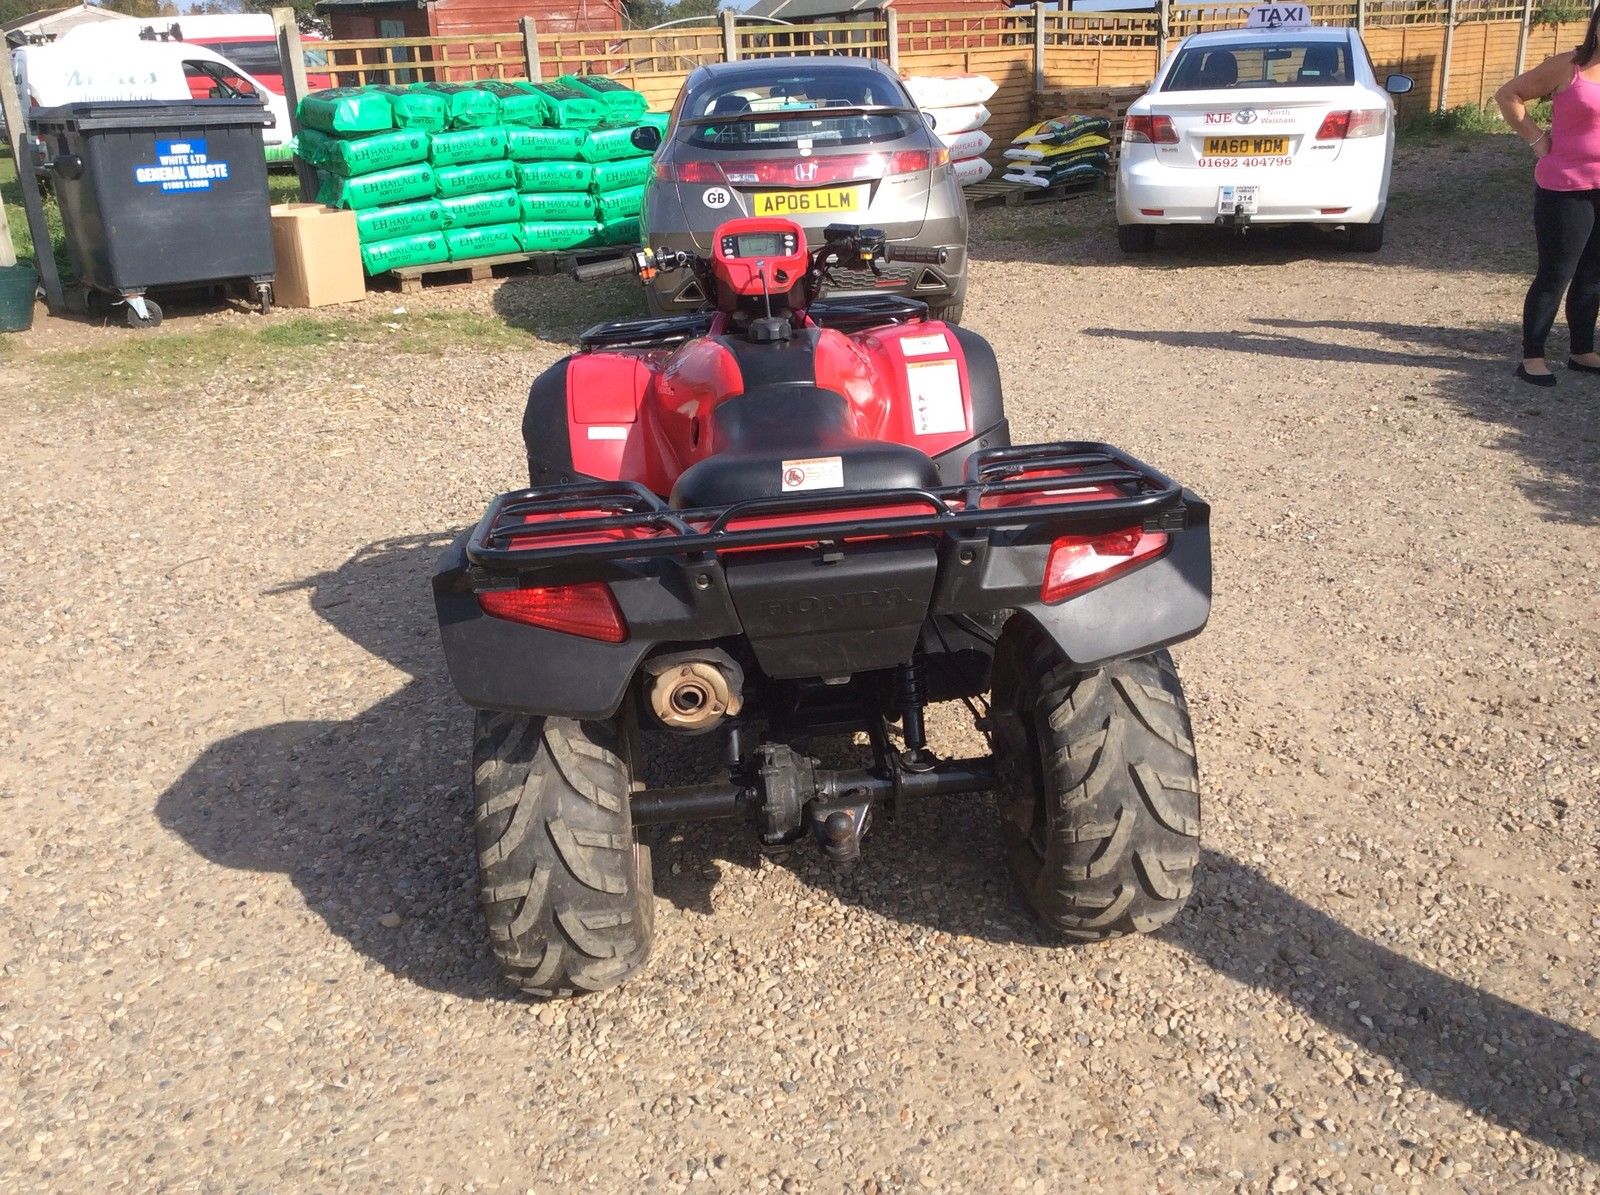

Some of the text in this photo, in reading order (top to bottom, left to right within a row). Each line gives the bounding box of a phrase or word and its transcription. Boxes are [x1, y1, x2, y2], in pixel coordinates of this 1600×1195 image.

[1257, 7, 1304, 22] TAXI
[1205, 112, 1232, 124] NJE
[436, 139, 487, 152] EH HAYLAGE
[521, 136, 570, 146] EH HAYLAGE
[596, 142, 609, 151] EH
[1210, 139, 1283, 154] MA60 WDM
[354, 142, 407, 161] EH HAYLAGE
[159, 153, 207, 166] WHITE LTD
[1198, 157, 1292, 168] 01692 404796
[136, 163, 228, 183] GENERAL WASTE
[526, 171, 572, 181] EH HAYLAGE
[605, 172, 619, 181] EH
[363, 177, 417, 194] EH HAYLAGE
[451, 173, 501, 187] EH HAYLAGE
[532, 200, 579, 209] EH HAYLAGE
[707, 192, 725, 204] GB
[764, 191, 850, 212] AP06 LLM
[452, 200, 505, 214] EH HAYLAGE
[372, 213, 426, 231] EH HAYLAGE
[536, 227, 584, 238] EH HAYLAGE
[459, 232, 510, 247] EH HAYLAGE
[372, 242, 424, 261] EH HAYLAGE
